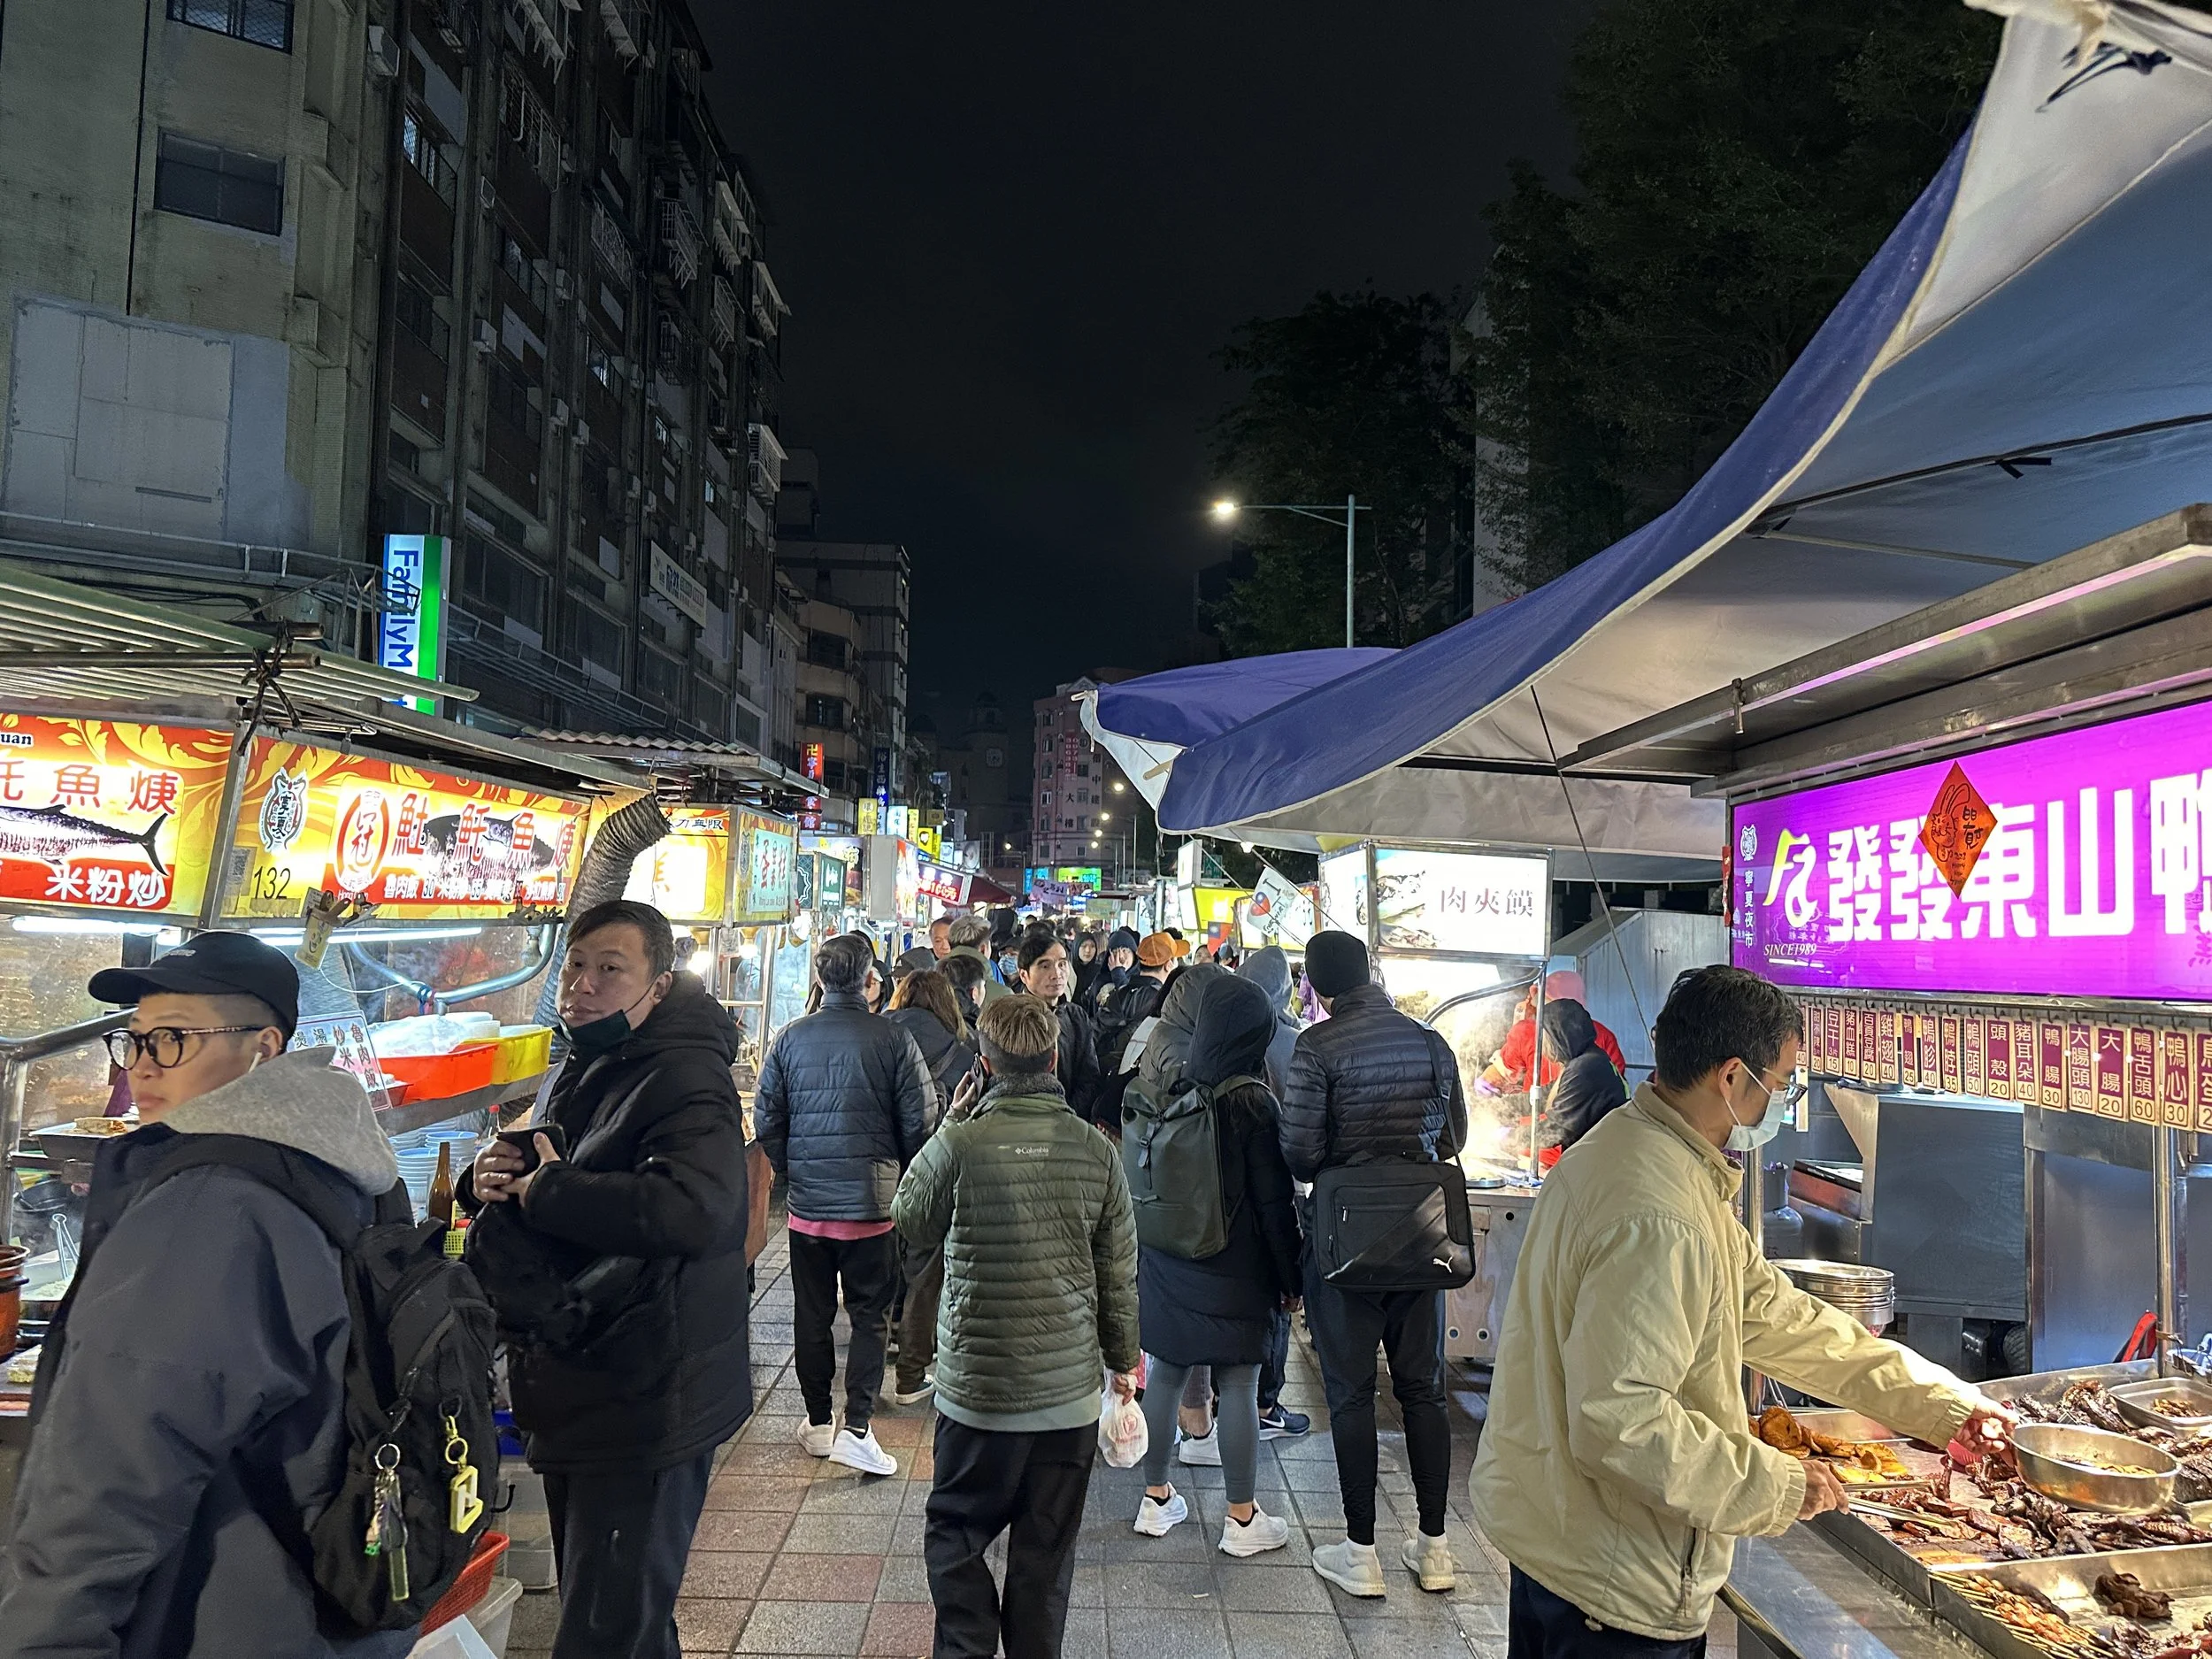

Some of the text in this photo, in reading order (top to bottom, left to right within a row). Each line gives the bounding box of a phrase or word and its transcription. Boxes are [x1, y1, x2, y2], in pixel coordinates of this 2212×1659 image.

[386, 550, 419, 706] FamilyMt
[45, 866, 166, 906] 米粉炒
[254, 866, 291, 899] 132
[1440, 886, 1533, 918] 肉夾饃
[1744, 871, 1755, 949] 寧夏夜市
[333, 1025, 359, 1080] 炒米
[351, 1023, 379, 1088] 魯肉飯
[1796, 1052, 1806, 1064] 40
[1827, 1010, 1839, 1047] 豆干
[1846, 1010, 1855, 1072] 豬血糕 10
[1863, 1014, 1875, 1077] 百頁豆腐 20
[1881, 1014, 1893, 1079] 雞翅 40
[1903, 1018, 1914, 1083] 鴨翅 25
[1967, 1023, 1979, 1092] 鴨頭 50
[1990, 1024, 2008, 1095] 頭殼 20
[2015, 1024, 2033, 1097] 豬耳朵 40
[1829, 1057, 1838, 1071] 15
[1924, 1071, 1936, 1085] 40
[1946, 1077, 1957, 1091] 35
[2044, 1028, 2060, 1103] 鴨腸 30
[2070, 1027, 2091, 1105] 大腸頭 130
[2101, 1033, 2121, 1113] 大腸 20
[2133, 1032, 2153, 1118] 鴨舌頭 60
[2165, 1036, 2187, 1122] 鴨心 30
